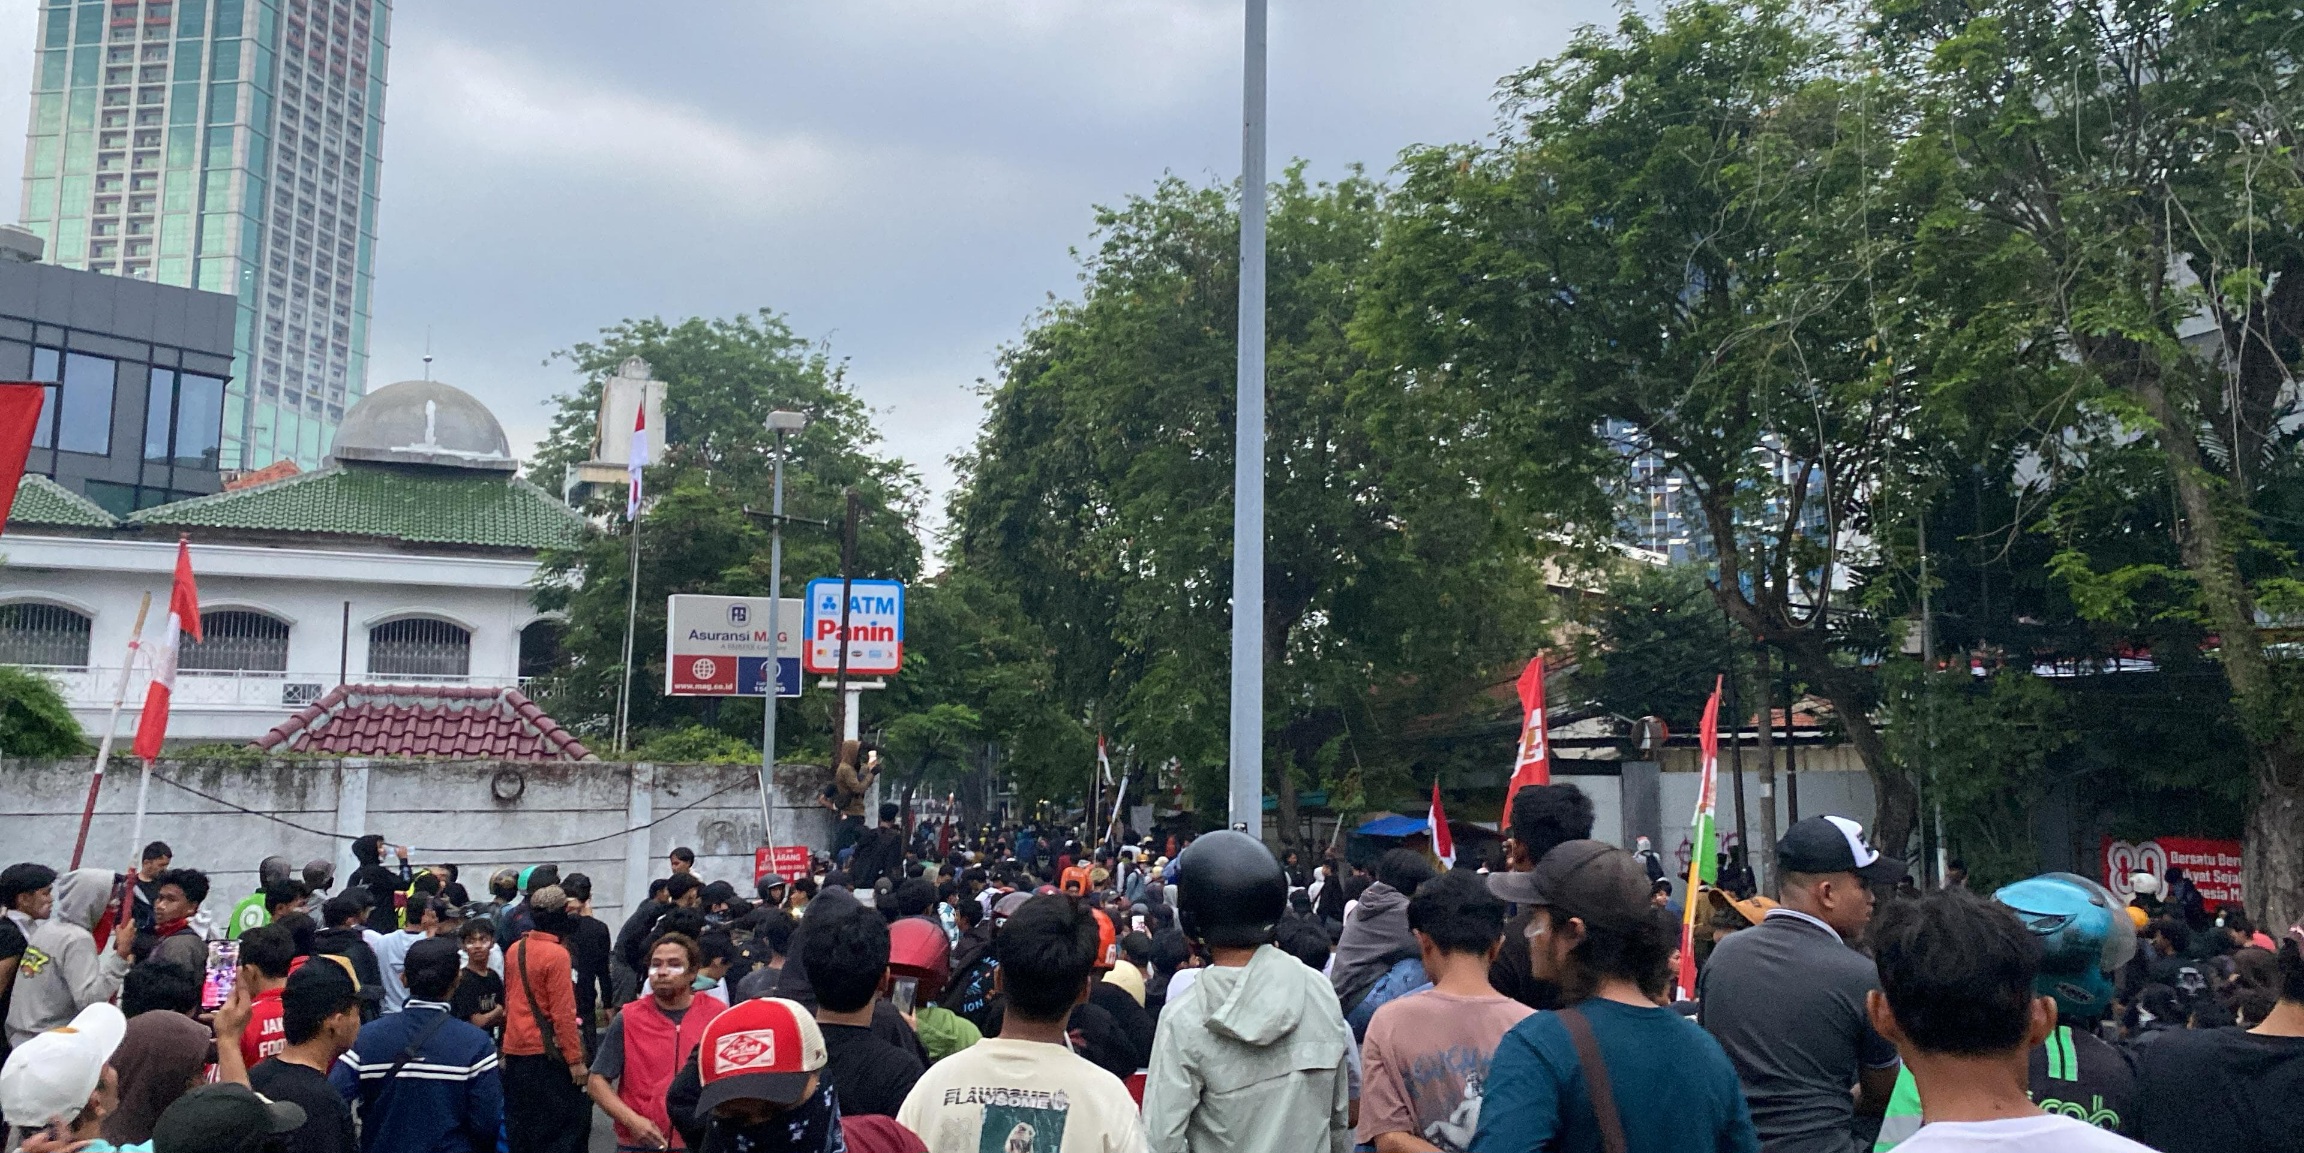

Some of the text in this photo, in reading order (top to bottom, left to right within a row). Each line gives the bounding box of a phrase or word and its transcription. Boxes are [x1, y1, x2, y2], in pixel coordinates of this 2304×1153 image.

[849, 596, 895, 615] ATM
[688, 629, 788, 643] Asuransi MG
[817, 619, 894, 642] Panin
[674, 682, 734, 691] www.mag.co.id
[2170, 851, 2215, 865] Bersatu
[258, 1038, 285, 1058] FOO
[943, 1087, 1050, 1110] FLAWSOME
